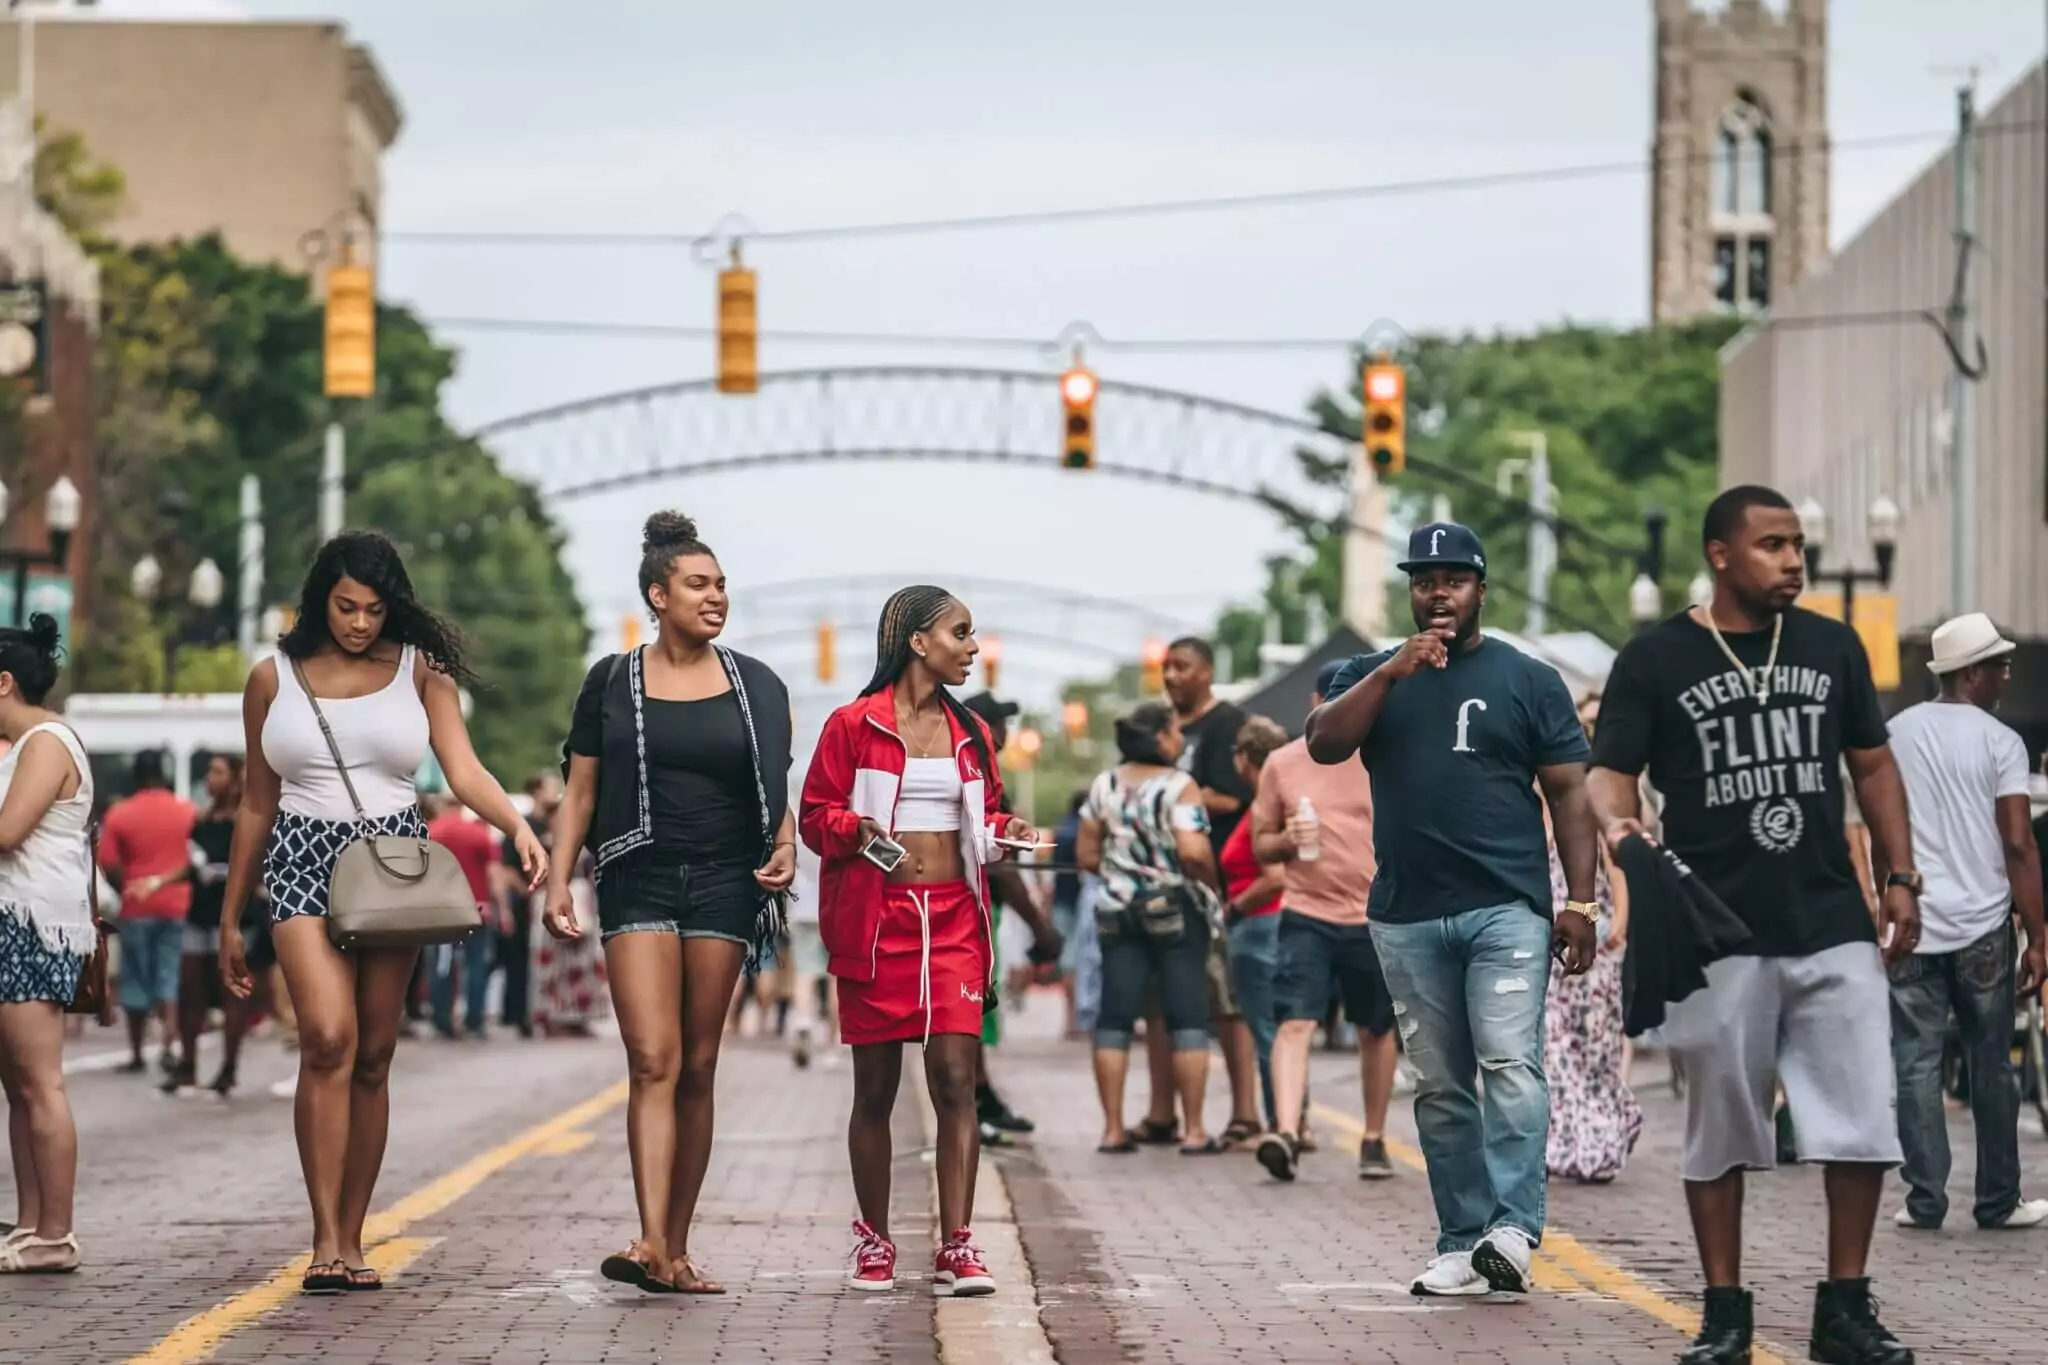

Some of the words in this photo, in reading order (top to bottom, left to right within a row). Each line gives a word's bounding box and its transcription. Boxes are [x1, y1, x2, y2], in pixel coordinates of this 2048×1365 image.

[1696, 704, 1827, 772] FLINT
[1705, 764, 1788, 808] ABOUT
[1795, 762, 1826, 793] ME
